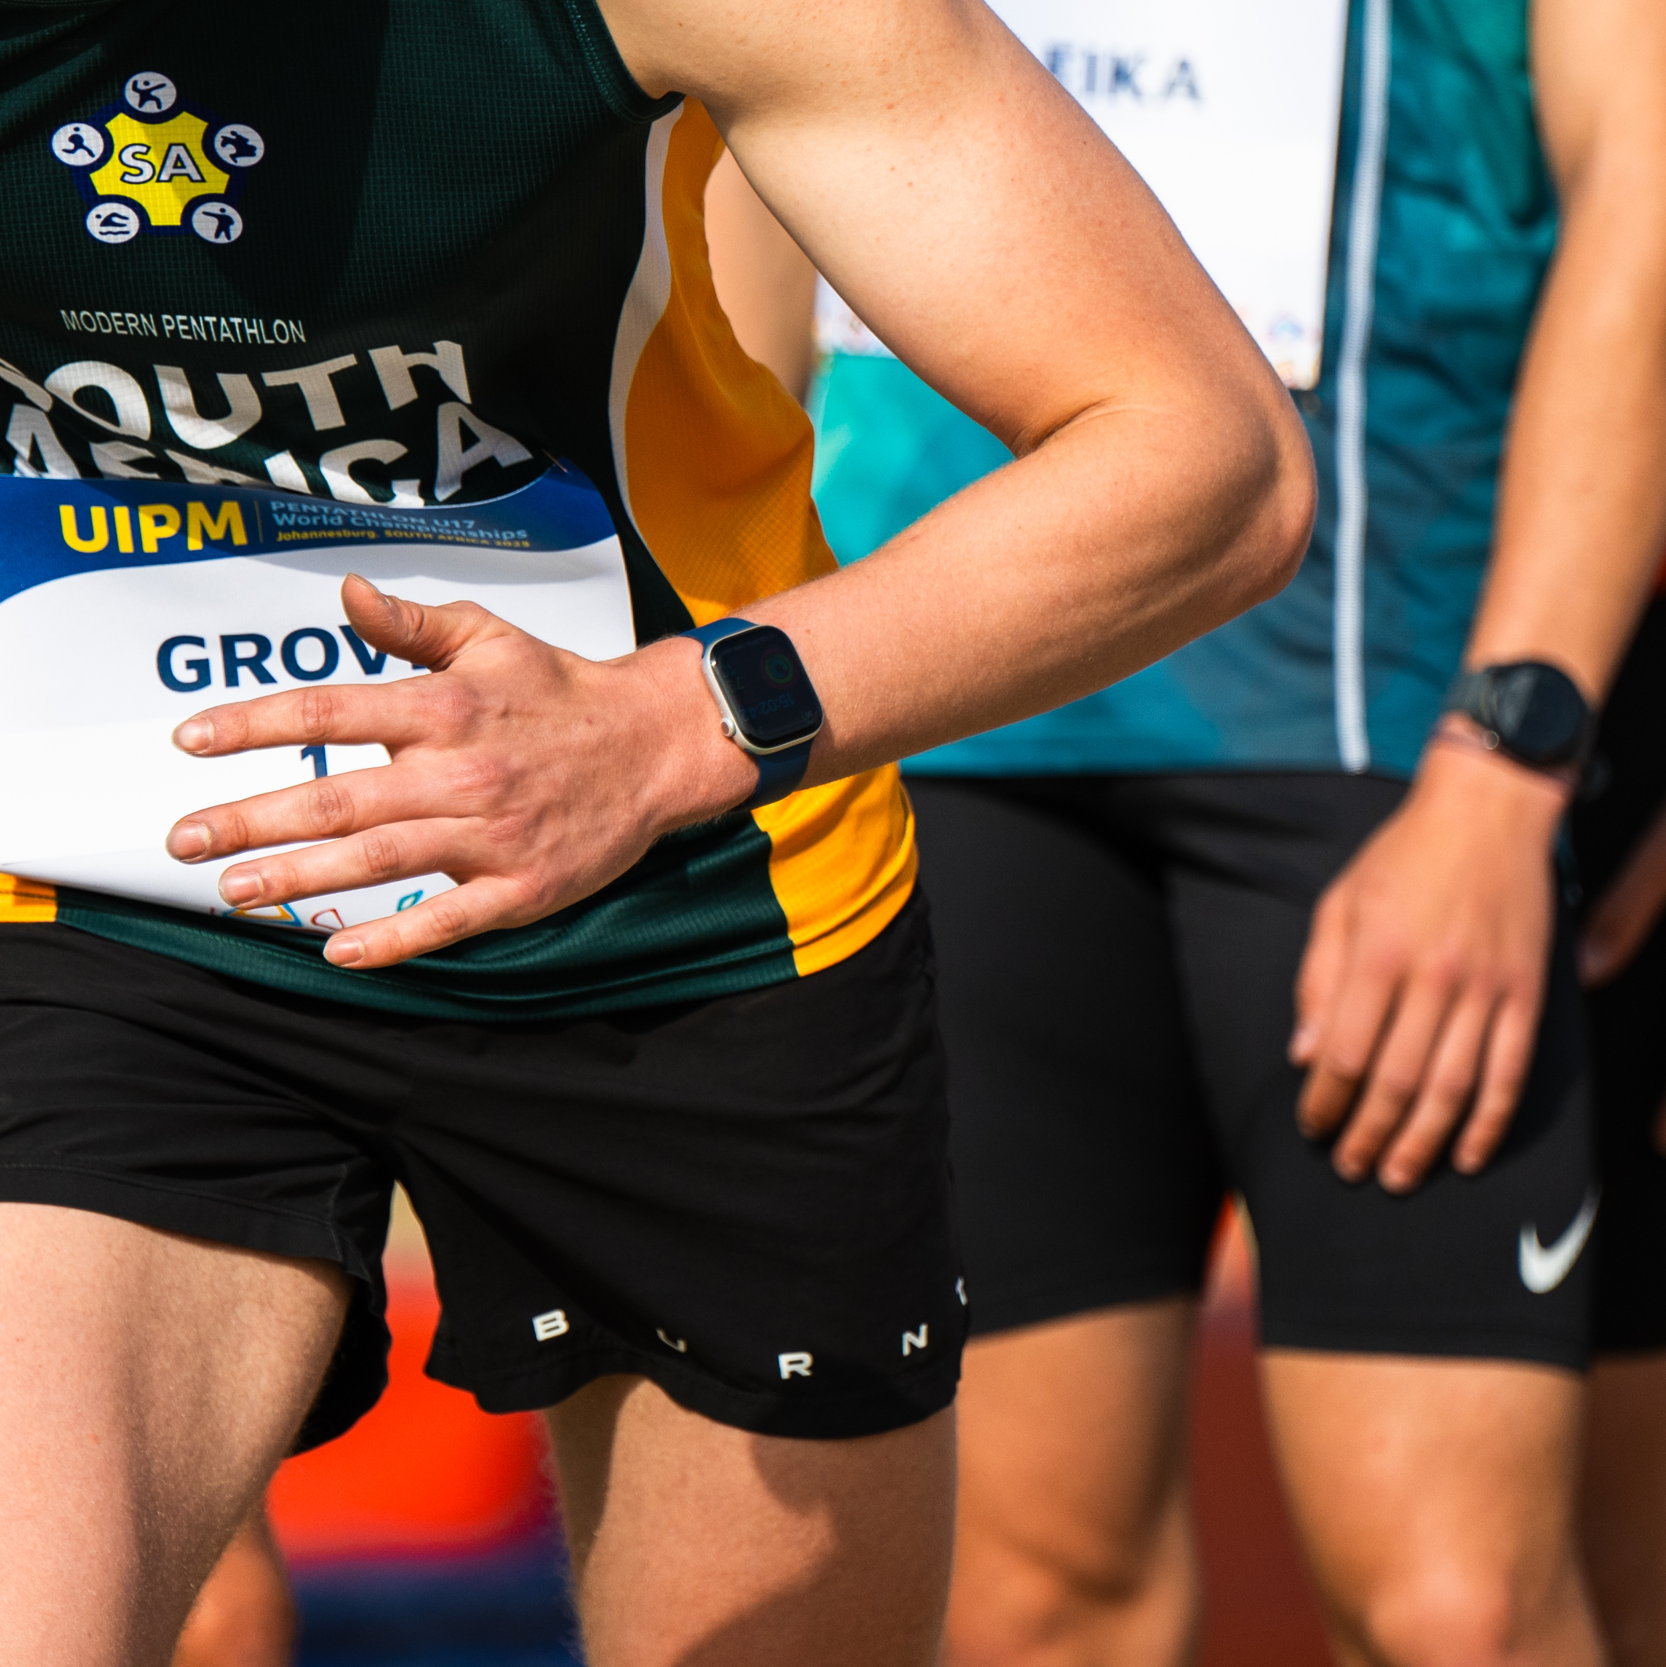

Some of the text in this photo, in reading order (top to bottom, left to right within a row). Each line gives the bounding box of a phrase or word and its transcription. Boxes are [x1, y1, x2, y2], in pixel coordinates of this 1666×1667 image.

[1044, 41, 1203, 104] EIKA
[118, 142, 207, 185] SA
[60, 309, 307, 344] MODERN PENTATHLON
[59, 500, 249, 554] UIPM
[270, 500, 476, 530] PENTATHLON U17
[273, 513, 528, 541] World Championships
[384, 529, 434, 540] SOUTH
[437, 534, 491, 546] AFRICA
[156, 622, 430, 693] GROV
